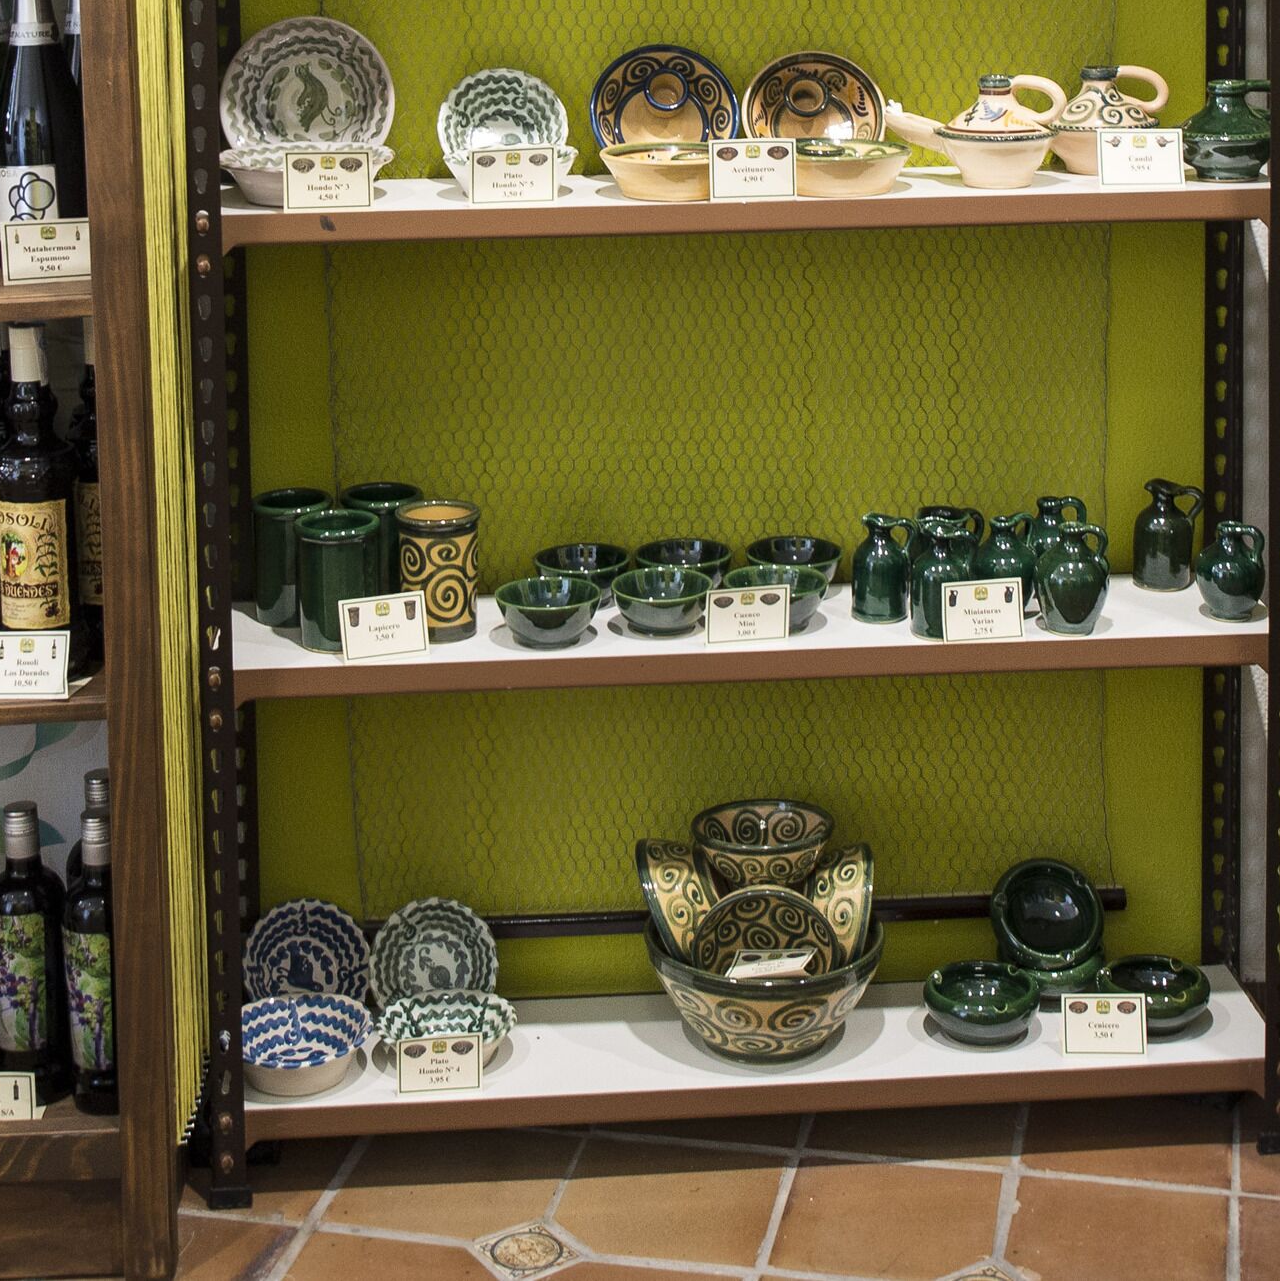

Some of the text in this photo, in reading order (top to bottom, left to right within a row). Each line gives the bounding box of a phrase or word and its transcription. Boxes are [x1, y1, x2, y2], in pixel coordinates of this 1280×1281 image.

[1128, 155, 1153, 163] Candil
[732, 166, 775, 174] Aceituneros
[23, 244, 77, 253] Matahermosa
[30, 255, 70, 264] Espumoso
[39, 264, 56, 273] 9,50
[0, 511, 46, 529] OSOLI
[733, 611, 761, 619] Cuenco
[963, 607, 1001, 615] Miniaturas
[971, 617, 994, 625] Varias
[368, 622, 401, 634] Lapicero
[4, 668, 50, 677] Los Duendes
[14, 679, 33, 688] 10,50
[1088, 1021, 1120, 1029] Cenicero
[418, 1067, 444, 1075] Hondo
